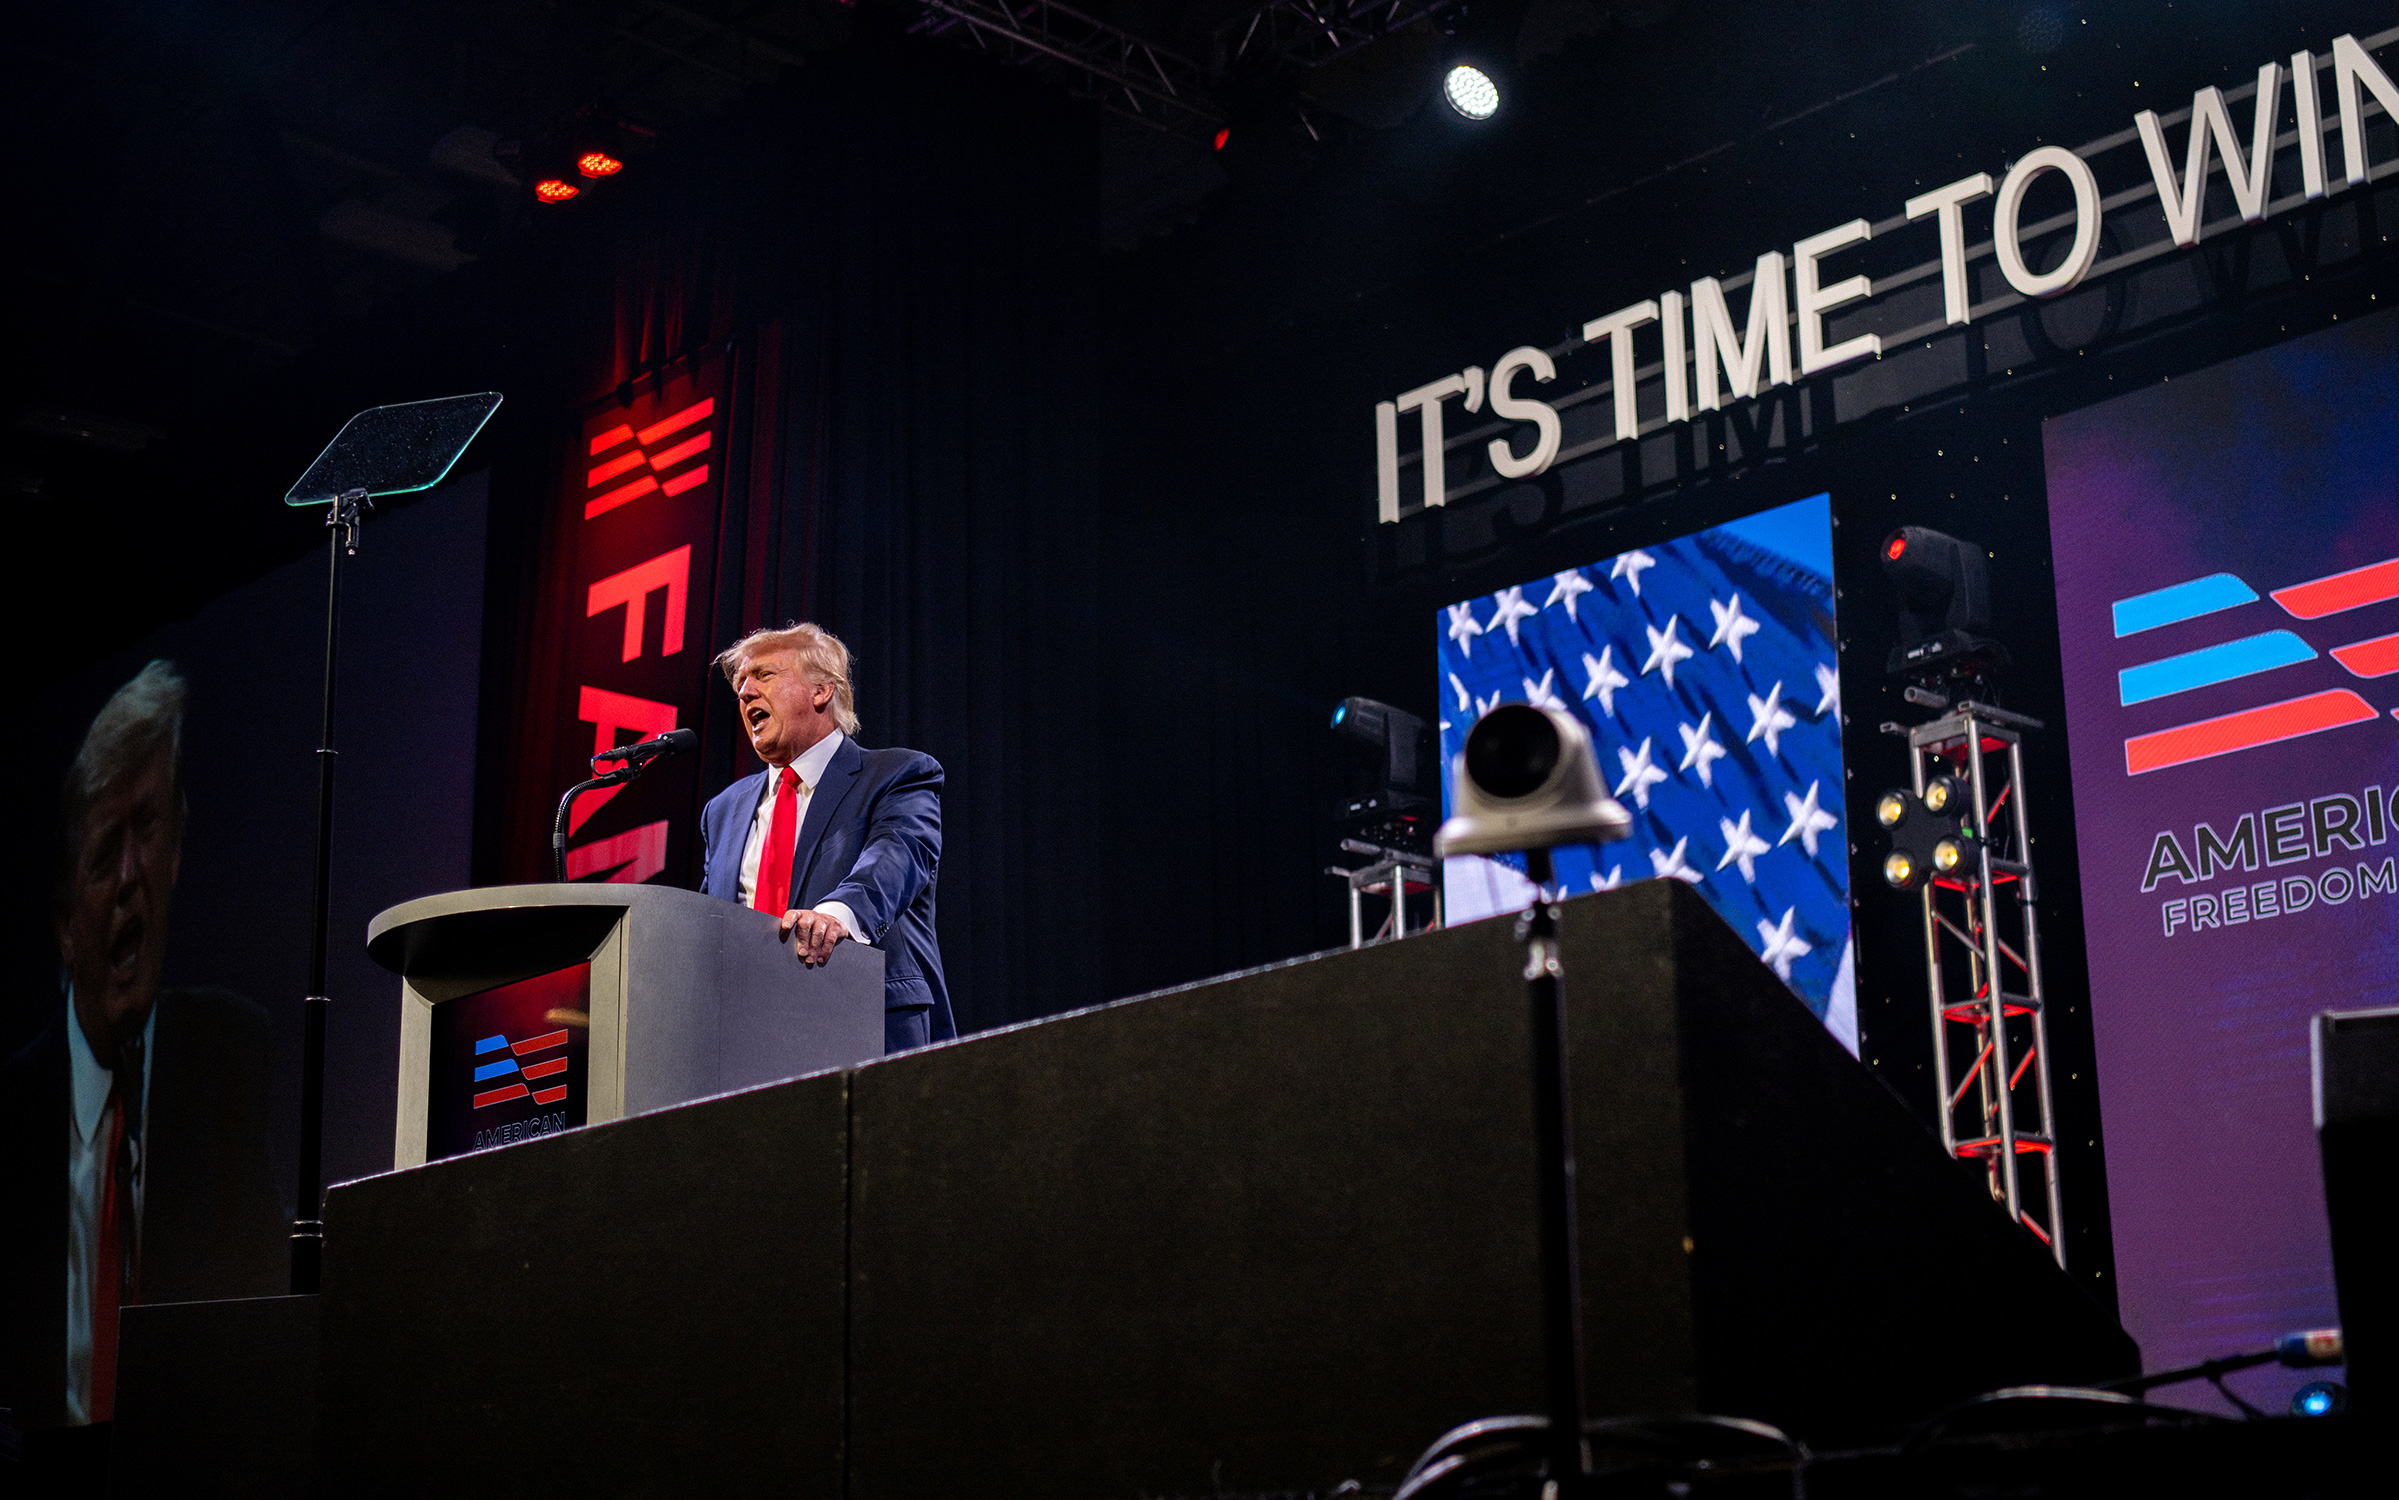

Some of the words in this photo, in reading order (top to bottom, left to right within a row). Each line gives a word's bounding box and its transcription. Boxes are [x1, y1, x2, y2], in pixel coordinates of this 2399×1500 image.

[1375, 346, 1561, 523] IT'S
[1583, 219, 1882, 441] TIME
[1905, 146, 2103, 326] TO
[2140, 784, 2399, 893] AMERI
[2162, 856, 2398, 937] FREEDOM
[473, 1111, 566, 1151] AMERICAN
